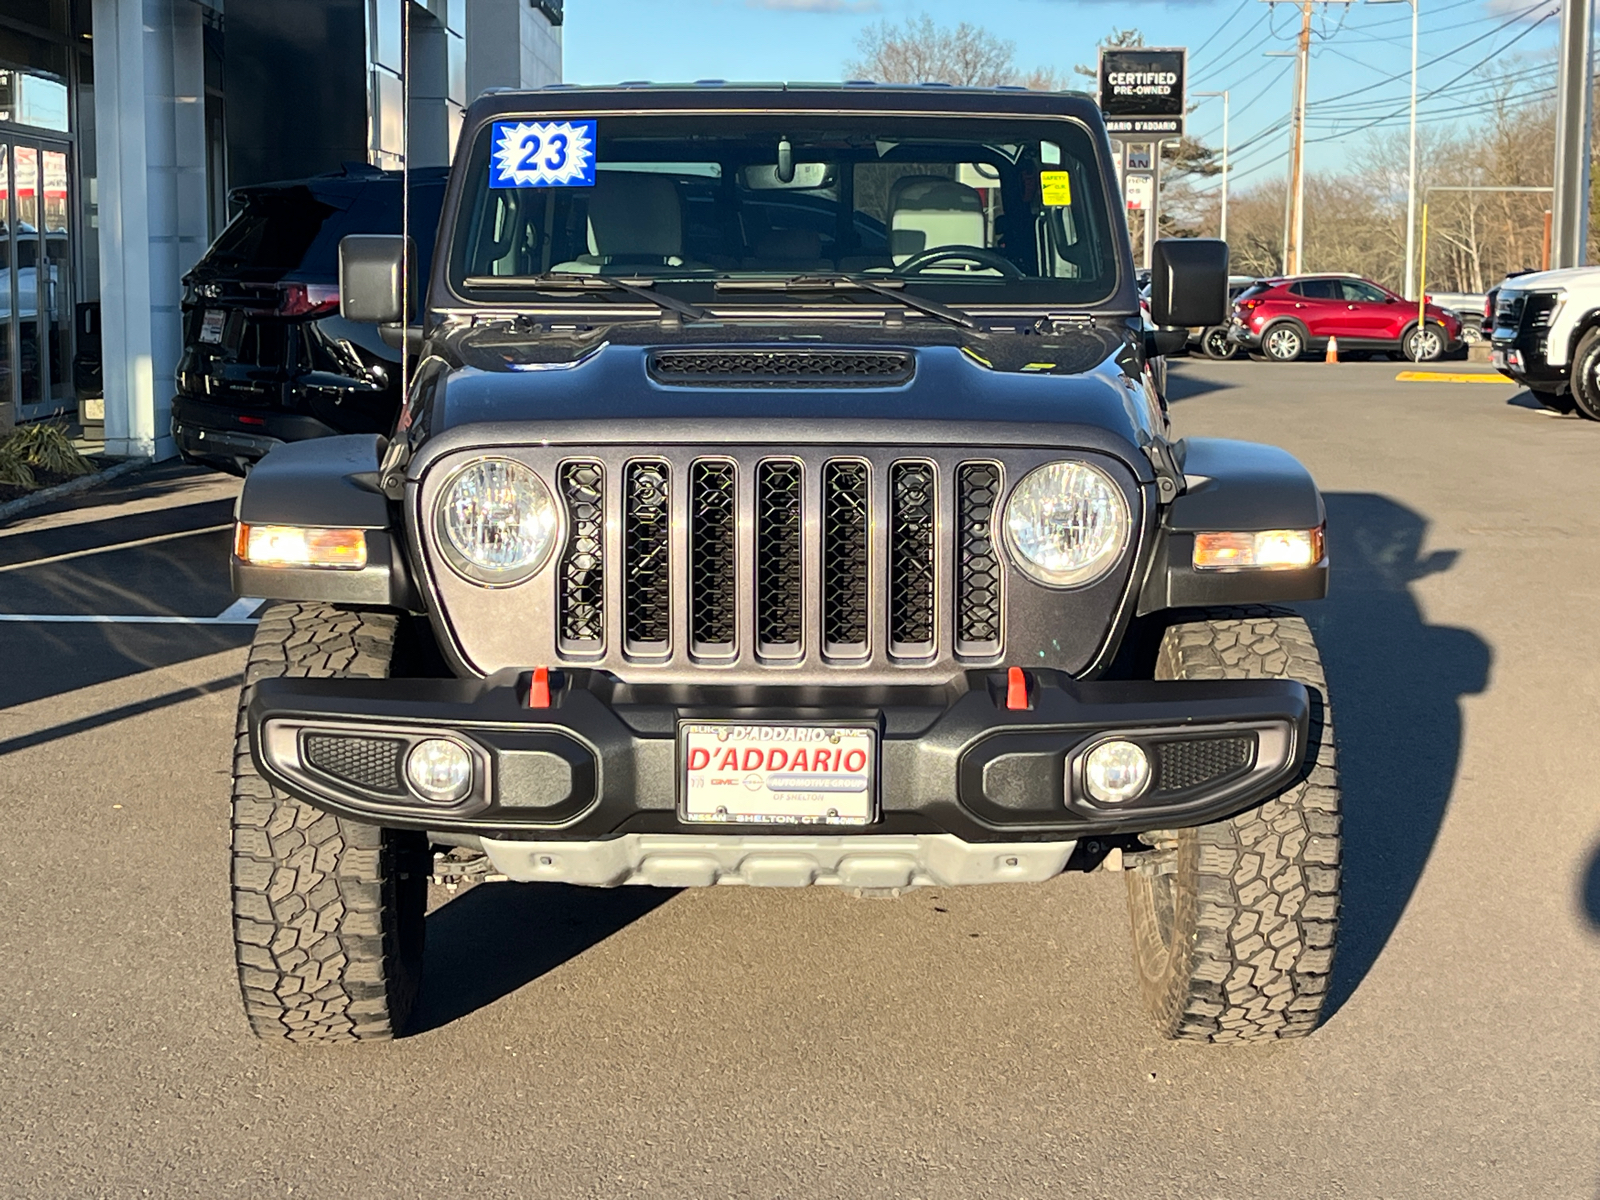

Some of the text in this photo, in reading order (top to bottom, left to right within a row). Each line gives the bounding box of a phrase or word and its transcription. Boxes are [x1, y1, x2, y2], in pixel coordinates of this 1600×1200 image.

[1108, 72, 1177, 85] CERTIFIED
[1113, 86, 1171, 95] PRE-OWNED
[1106, 121, 1177, 131] MARIO D'ADDARIO
[515, 133, 569, 171] 23
[732, 726, 825, 742] D'ADDARIO
[688, 747, 867, 772] D'ADDARIO
[710, 778, 740, 786] GMC
[771, 778, 830, 788] AUTOMOTIVE
[831, 779, 865, 788] GROUP
[773, 793, 825, 801] OF SHELTON
[687, 813, 727, 822] NISSAN
[734, 814, 799, 824] SHELTON,
[801, 816, 819, 825] CT
